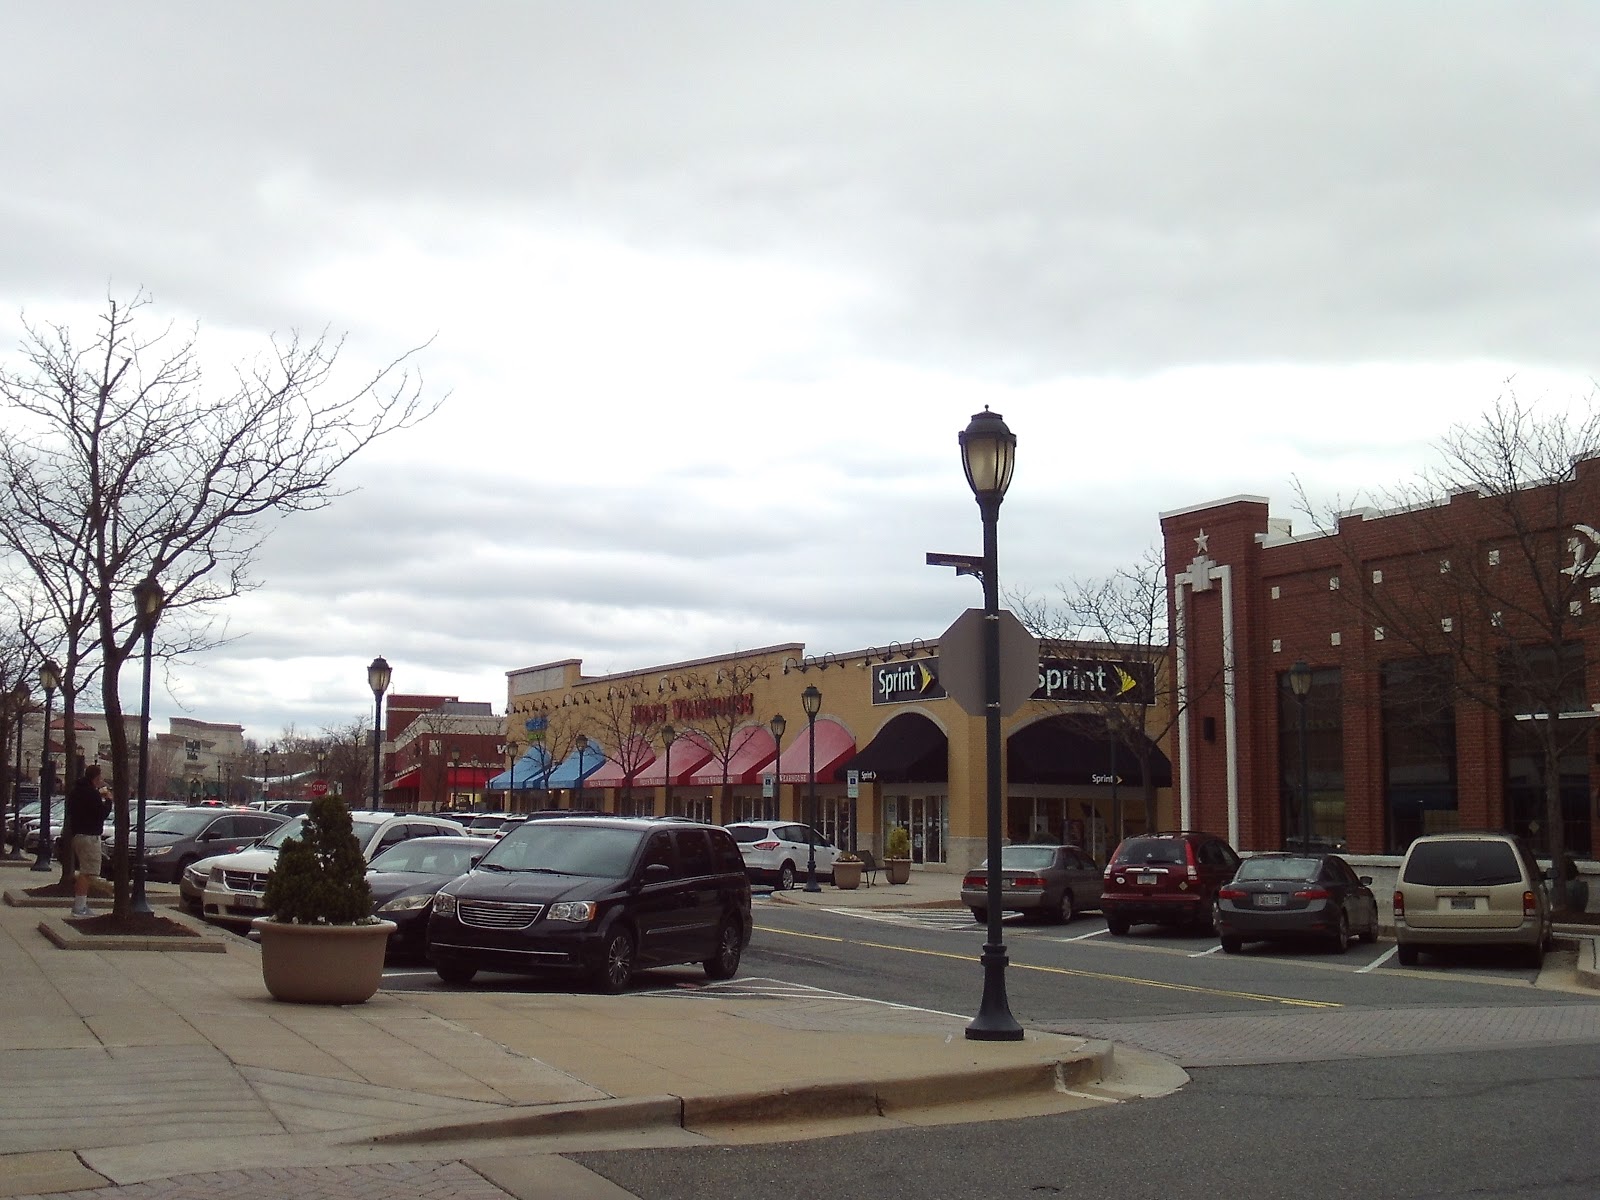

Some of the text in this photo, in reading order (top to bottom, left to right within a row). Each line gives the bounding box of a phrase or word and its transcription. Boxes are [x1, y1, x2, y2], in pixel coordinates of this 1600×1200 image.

[878, 664, 916, 700] Sprint
[1091, 773, 1113, 785] Sprint
[312, 784, 327, 792] STOP
